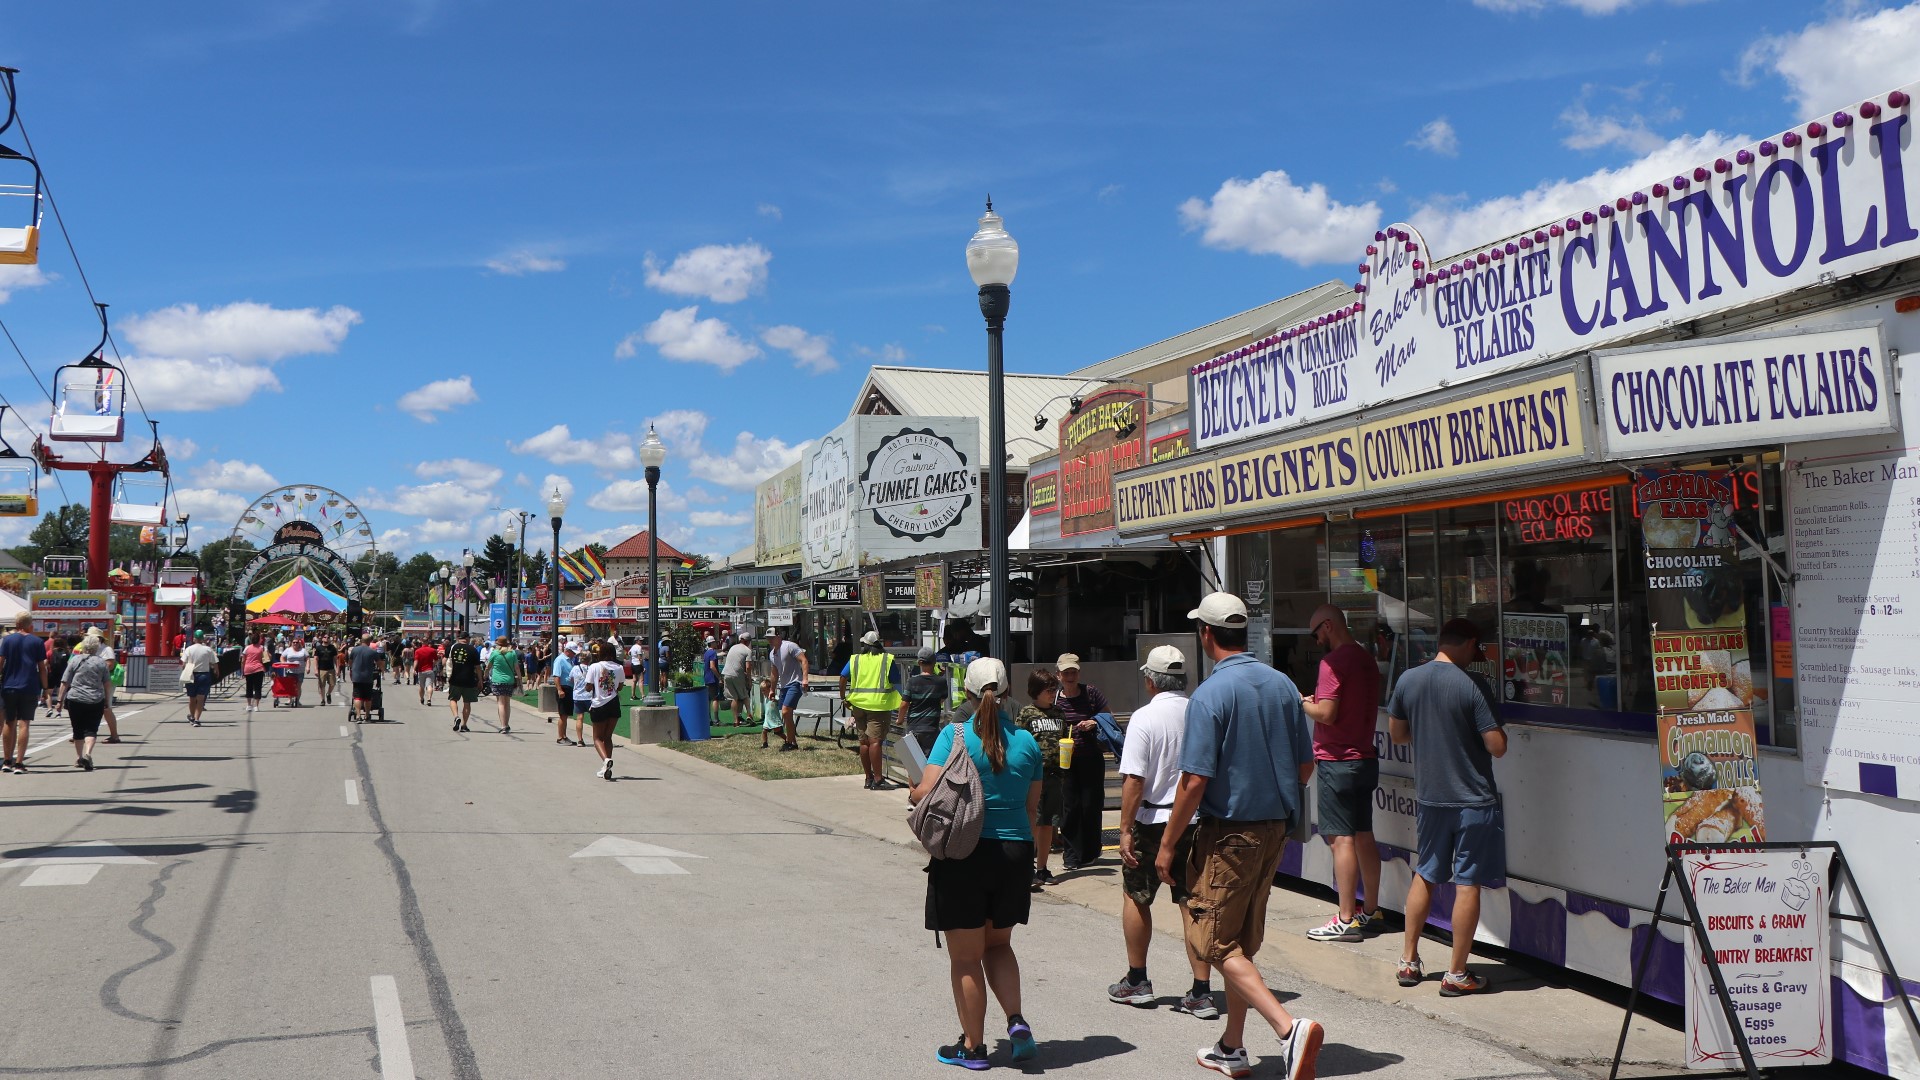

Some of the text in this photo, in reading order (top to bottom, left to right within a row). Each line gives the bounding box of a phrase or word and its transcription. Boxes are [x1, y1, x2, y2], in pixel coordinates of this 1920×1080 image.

[1560, 114, 1919, 335] CANNOLI
[1379, 250, 1405, 285] The
[1435, 248, 1553, 328] CHOCOLATE
[1370, 285, 1419, 346] Baker
[1454, 303, 1535, 369] ECLAIRS
[1300, 319, 1358, 373] CINNAMON
[1375, 336, 1417, 387] Man
[1200, 344, 1297, 439] BEIGNETS
[1312, 364, 1348, 408] ROLLS
[1612, 346, 1878, 436] CHOCOLATE ECLAIRS
[1068, 407, 1097, 450] PICKLE
[1364, 387, 1569, 482] COUNTRY BREAKFAST
[887, 439, 901, 451] HOT
[914, 435, 939, 447] FRESH
[894, 458, 939, 475] Gourmet
[1221, 437, 1357, 505] BEIGNETS
[1803, 463, 1918, 489] The Baker Man
[868, 469, 968, 505] FUNNEL CAKES
[1118, 467, 1217, 522] ELEPHANT EARS
[1639, 473, 1730, 503] ELEPHANT
[1506, 488, 1612, 521] CHOCOLATE
[1659, 500, 1709, 519] EARS
[1794, 506, 1811, 514] Giant
[1813, 504, 1848, 513] Cinnamon
[888, 505, 957, 532] CHERRY LIMEADE
[1795, 514, 1852, 525] Chocolate Eclairs
[1520, 515, 1593, 543] ECLAIRS
[1795, 526, 1840, 538] Elephant Ears
[268, 543, 301, 560] STATE
[303, 544, 332, 562] FAIR
[1795, 540, 1824, 549] Beignets
[1646, 555, 1722, 569] CHOCOLATE
[1796, 549, 1849, 559] Cinnamon Bites
[1796, 561, 1837, 570] Stuffed Ears
[733, 575, 755, 586] PEANUT
[828, 585, 848, 593] CHERRY
[1649, 575, 1702, 589] ECLAIRS
[827, 592, 848, 601] LIMEADE
[895, 586, 916, 596] PEANU
[1837, 593, 1900, 603] Breakfast Served
[38, 599, 99, 607] RIDE TICKETS
[1854, 607, 1870, 615] From
[1870, 604, 1876, 615] 6
[683, 611, 714, 619] SWEET
[496, 620, 502, 628] 3
[1799, 627, 1827, 637] Country
[1653, 633, 1744, 653] NEW ORLEANS
[1655, 655, 1701, 672] STYLE
[1800, 663, 1837, 672] Scrambled
[1860, 665, 1891, 675] Sausage
[1893, 667, 1918, 677] Links,
[1657, 672, 1728, 691] BEIGNETS
[1800, 674, 1806, 682] &
[1808, 674, 1826, 683] Fried
[1802, 696, 1861, 709] Biscuits & Gravy
[1676, 712, 1735, 726] Fresh Made
[1667, 726, 1753, 768] Cinnamon
[1822, 746, 1920, 765] Ice Cold Drinks & Hot Cof
[1715, 759, 1755, 789] ROLLS
[1376, 787, 1417, 817] Orlea
[1703, 877, 1776, 894] The Baker Man
[1708, 914, 1807, 930] BISCUITS & GRAVY
[1753, 934, 1763, 944] OR
[1755, 947, 1814, 963] BREAKFAST
[1709, 981, 1808, 995] Bcuits & Gravy
[1731, 1000, 1782, 1013] Sausage
[1745, 1017, 1775, 1031] Eggs
[1733, 1034, 1787, 1046] tatoes
